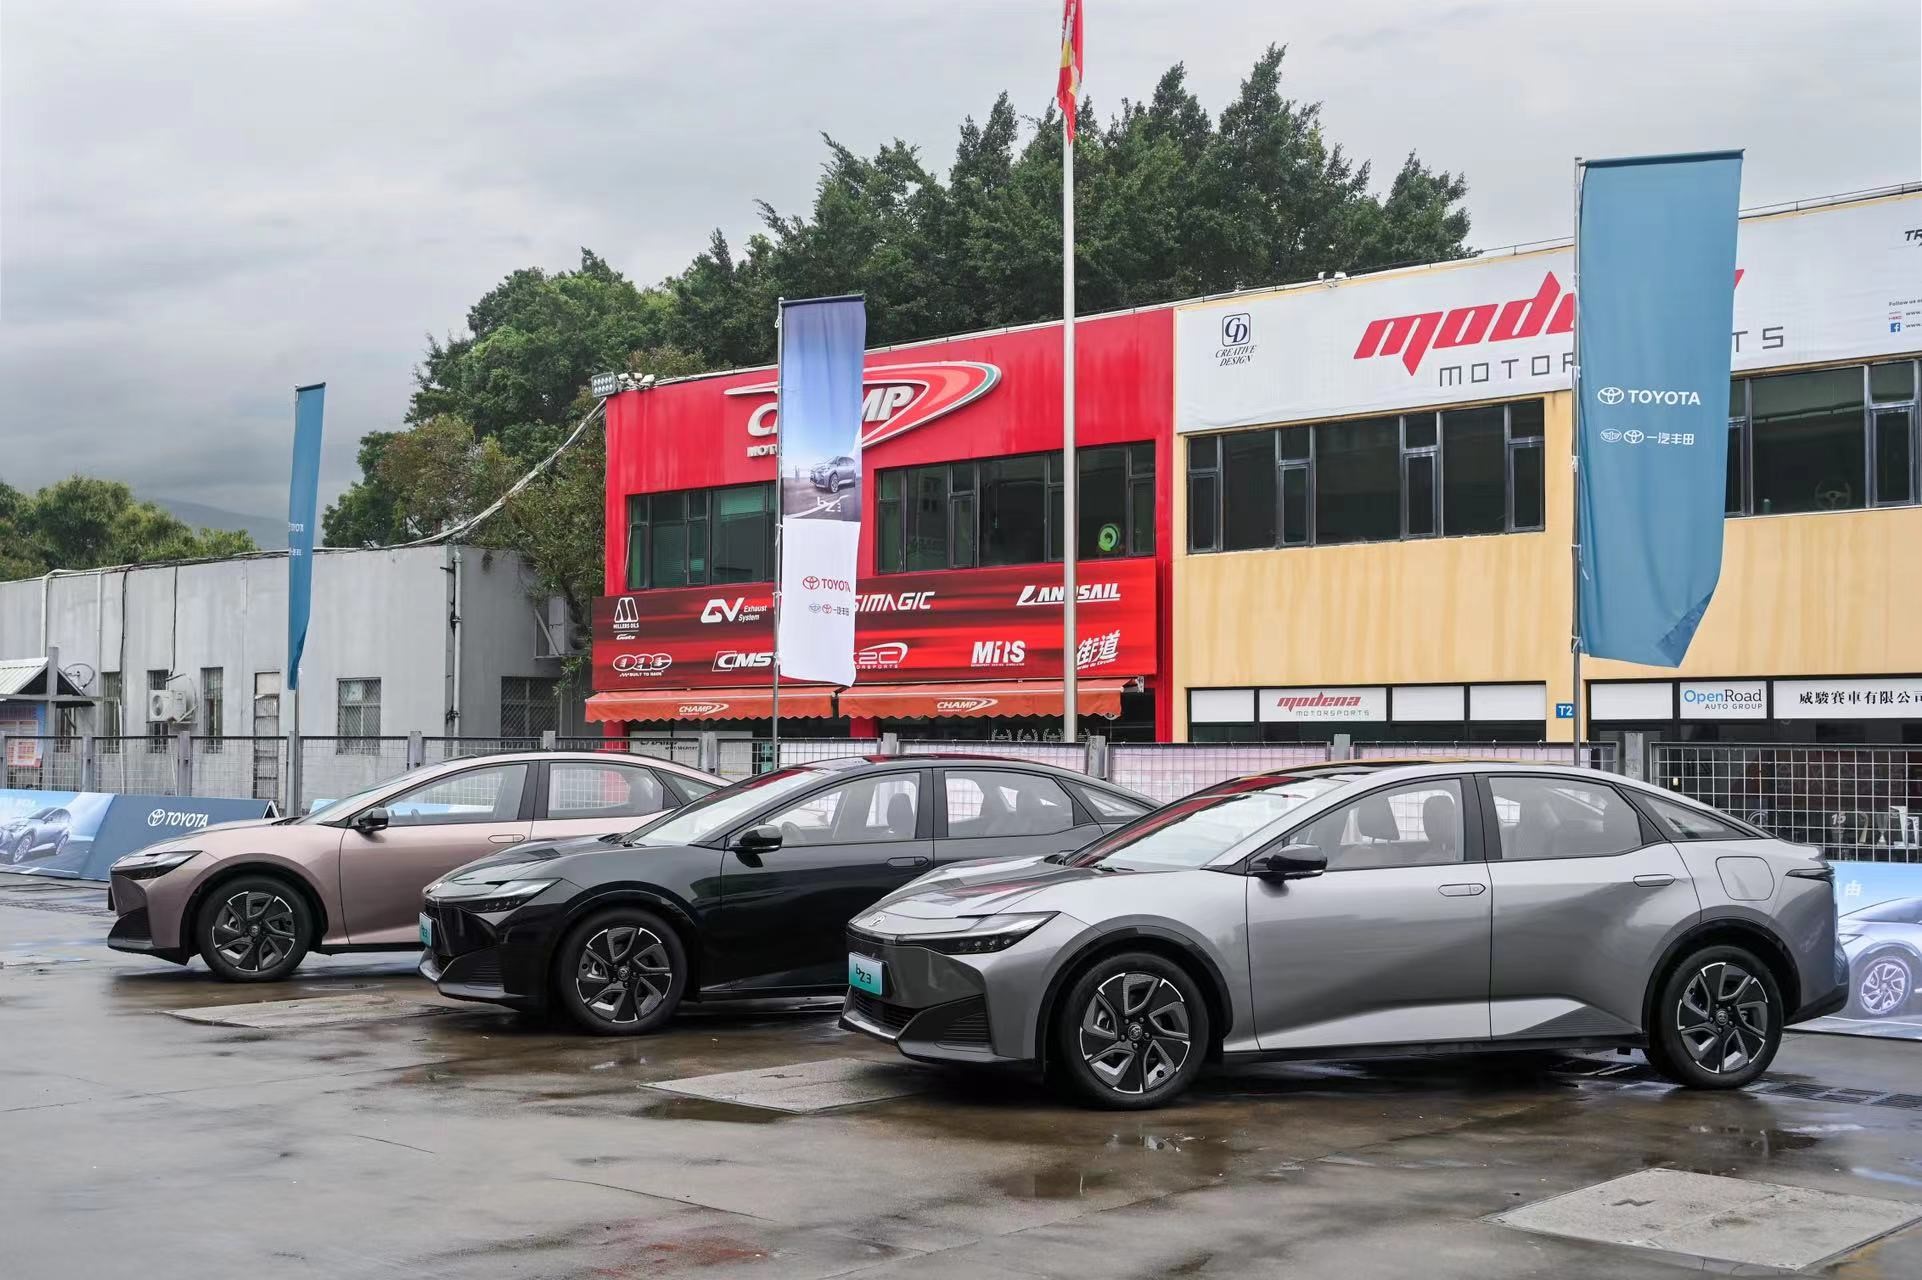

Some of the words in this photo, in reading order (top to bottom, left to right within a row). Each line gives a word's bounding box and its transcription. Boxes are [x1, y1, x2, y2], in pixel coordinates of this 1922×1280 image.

[1225, 317, 1248, 343] CD
[1215, 345, 1257, 358] CREATIVE
[1220, 355, 1253, 367] DESIGN
[1628, 389, 1701, 406] TOYOTA
[748, 385, 914, 437] CMP
[1646, 432, 1694, 446] 一汽丰田
[1016, 583, 1121, 606] LANSAIL
[743, 605, 768, 613] Exhaust
[738, 614, 760, 623] System
[716, 651, 774, 668] CMS
[1276, 691, 1361, 712] modena
[1684, 689, 1762, 704] OpenRoad
[679, 705, 713, 713] CHAMP
[936, 701, 978, 709] CHAMP
[1558, 705, 1573, 717] T2
[165, 811, 209, 828] TOYOTA
